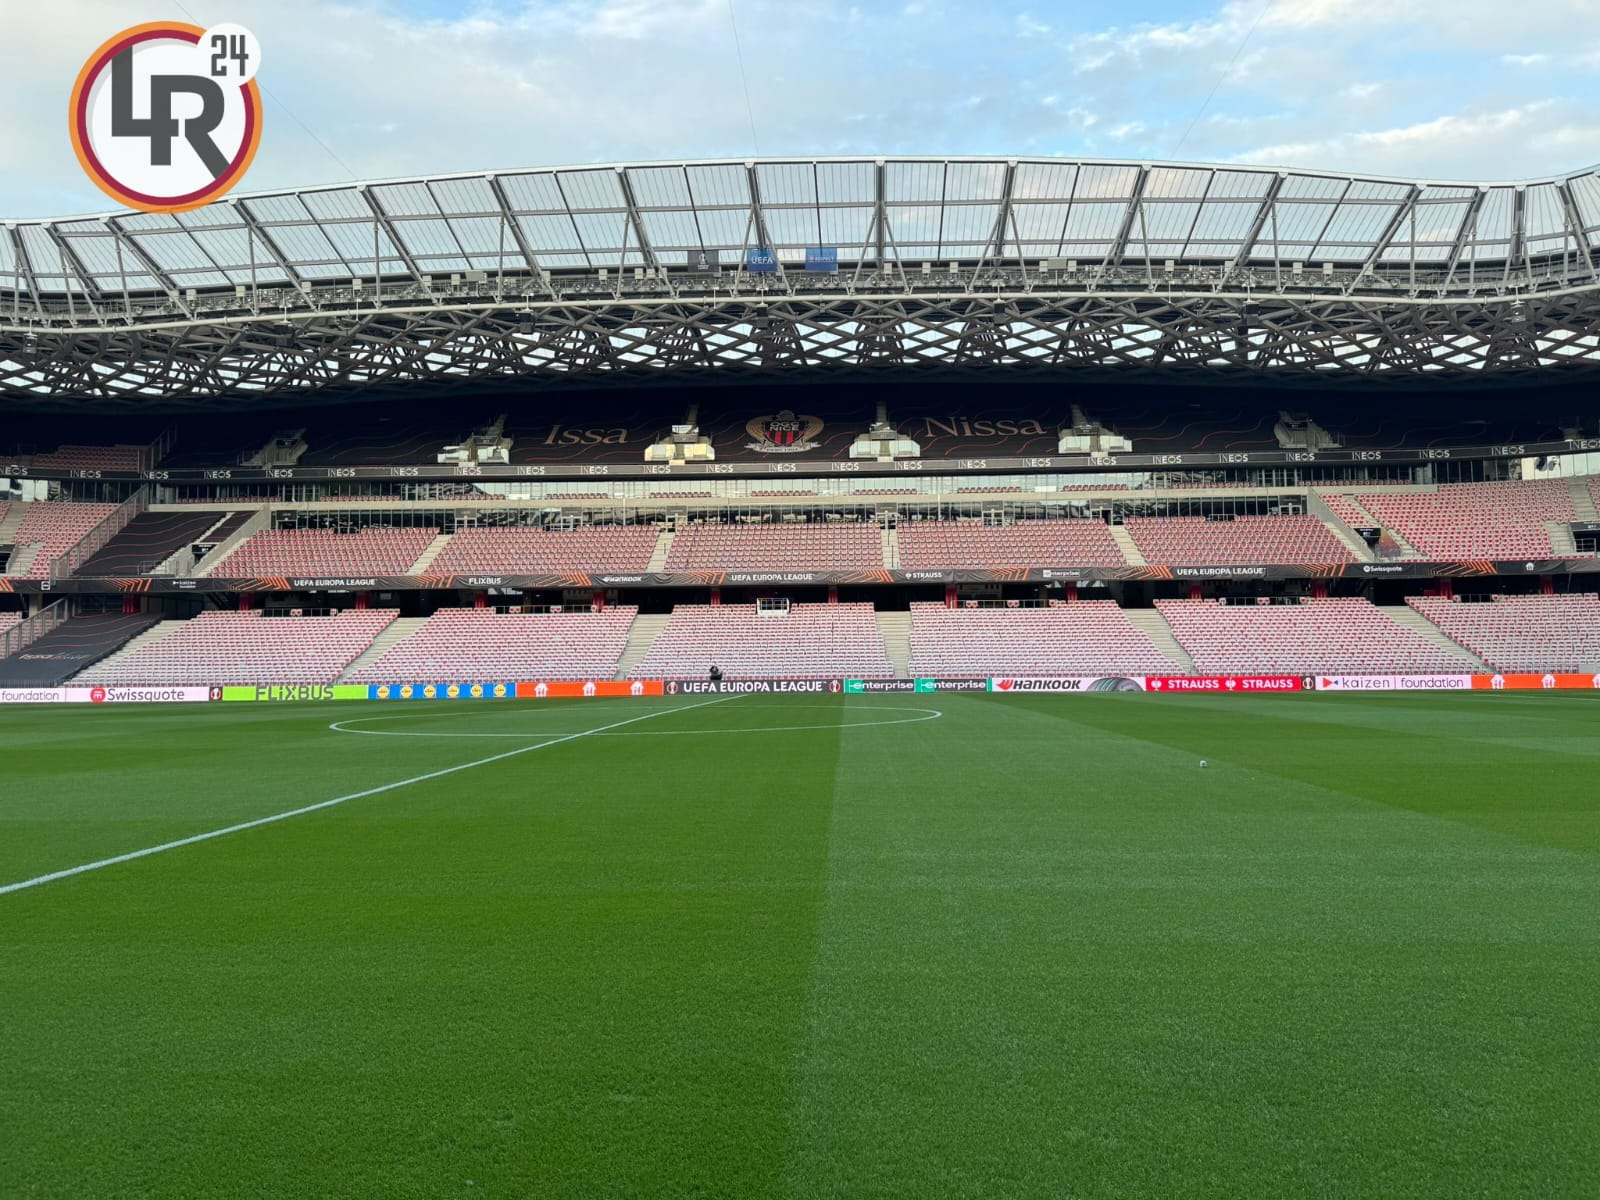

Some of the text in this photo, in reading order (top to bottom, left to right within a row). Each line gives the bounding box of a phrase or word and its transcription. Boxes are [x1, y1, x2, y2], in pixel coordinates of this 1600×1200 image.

[751, 256, 774, 264] UEFA
[924, 416, 1047, 437] Nissa
[544, 424, 627, 444] Issa
[1570, 440, 1600, 449] INEO
[1419, 450, 1450, 459] INEOS
[1492, 446, 1524, 455] INEOS
[1152, 455, 1182, 464] INEOS
[1219, 454, 1248, 462] INEOS
[1286, 453, 1315, 461] INEOS
[1352, 451, 1381, 460] INEOS
[958, 460, 986, 468] INEOS
[1022, 458, 1050, 467] INEOS
[1088, 456, 1116, 465] INEOS
[580, 466, 608, 474] INEOS
[644, 465, 671, 474] INEOS
[706, 465, 734, 473] INEOS
[768, 464, 796, 472] INEOS
[832, 463, 859, 471] INEOS
[894, 461, 922, 470] INEOS
[70, 470, 101, 478] INEOS
[266, 469, 292, 478] INEOS
[328, 469, 355, 477] INEOS
[390, 468, 418, 476] INEOS
[454, 467, 482, 475] INEOS
[517, 466, 545, 475] INEOS
[140, 472, 168, 480] INEOS
[684, 681, 822, 693] UEFA EUROPA LEAGUE
[849, 680, 913, 690] enterprise
[922, 680, 985, 690] enterprise
[1168, 679, 1219, 688] STRAUSS
[1242, 679, 1293, 688] STRAUSS
[1343, 677, 1463, 689] kaizen foundation
[2, 688, 59, 701] foundation
[108, 689, 184, 702] Swissquote
